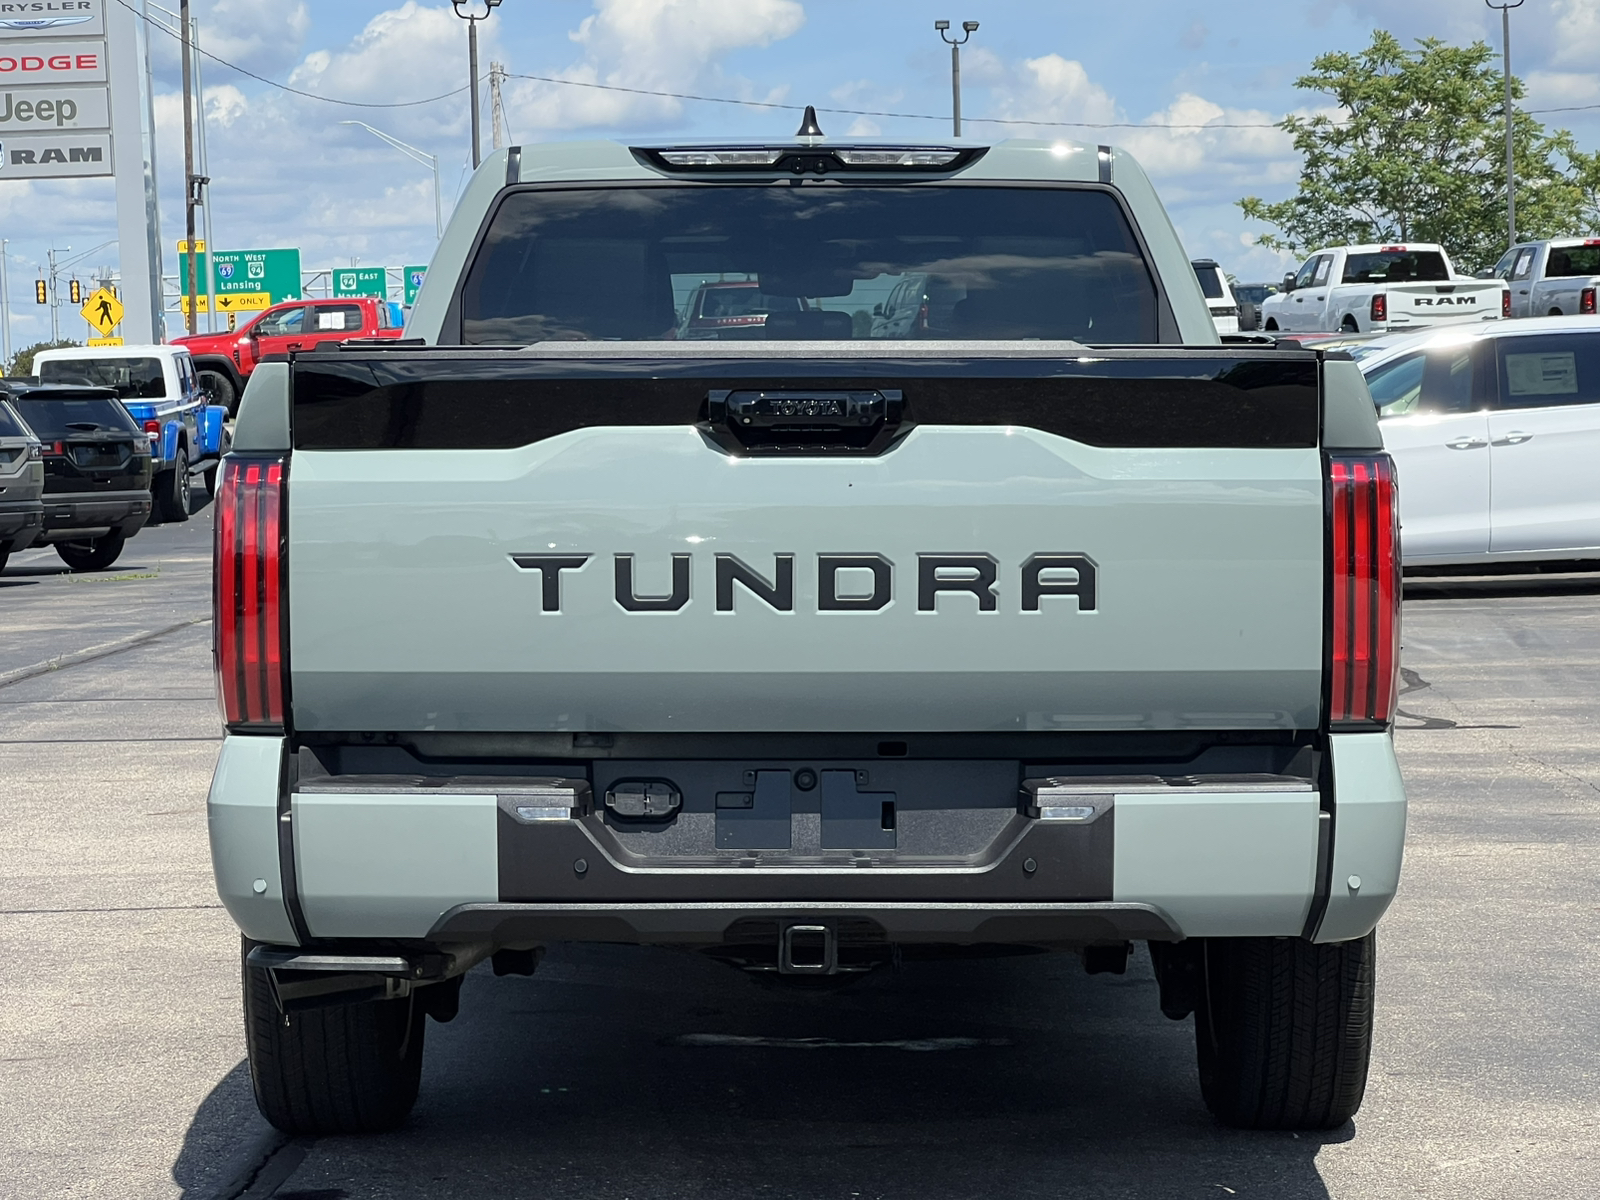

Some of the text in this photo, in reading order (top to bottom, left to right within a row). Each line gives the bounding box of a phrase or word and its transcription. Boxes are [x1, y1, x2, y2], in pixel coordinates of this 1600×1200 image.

[0, 93, 77, 127] Jeep
[11, 147, 103, 165] RAM
[244, 253, 266, 261] WEST
[221, 267, 232, 276] 69
[221, 280, 261, 290] Lansing
[240, 298, 264, 306] ONLY
[1414, 296, 1476, 306] RAM
[770, 400, 842, 416] TOYOTA
[509, 553, 1100, 614] TUNDRA
